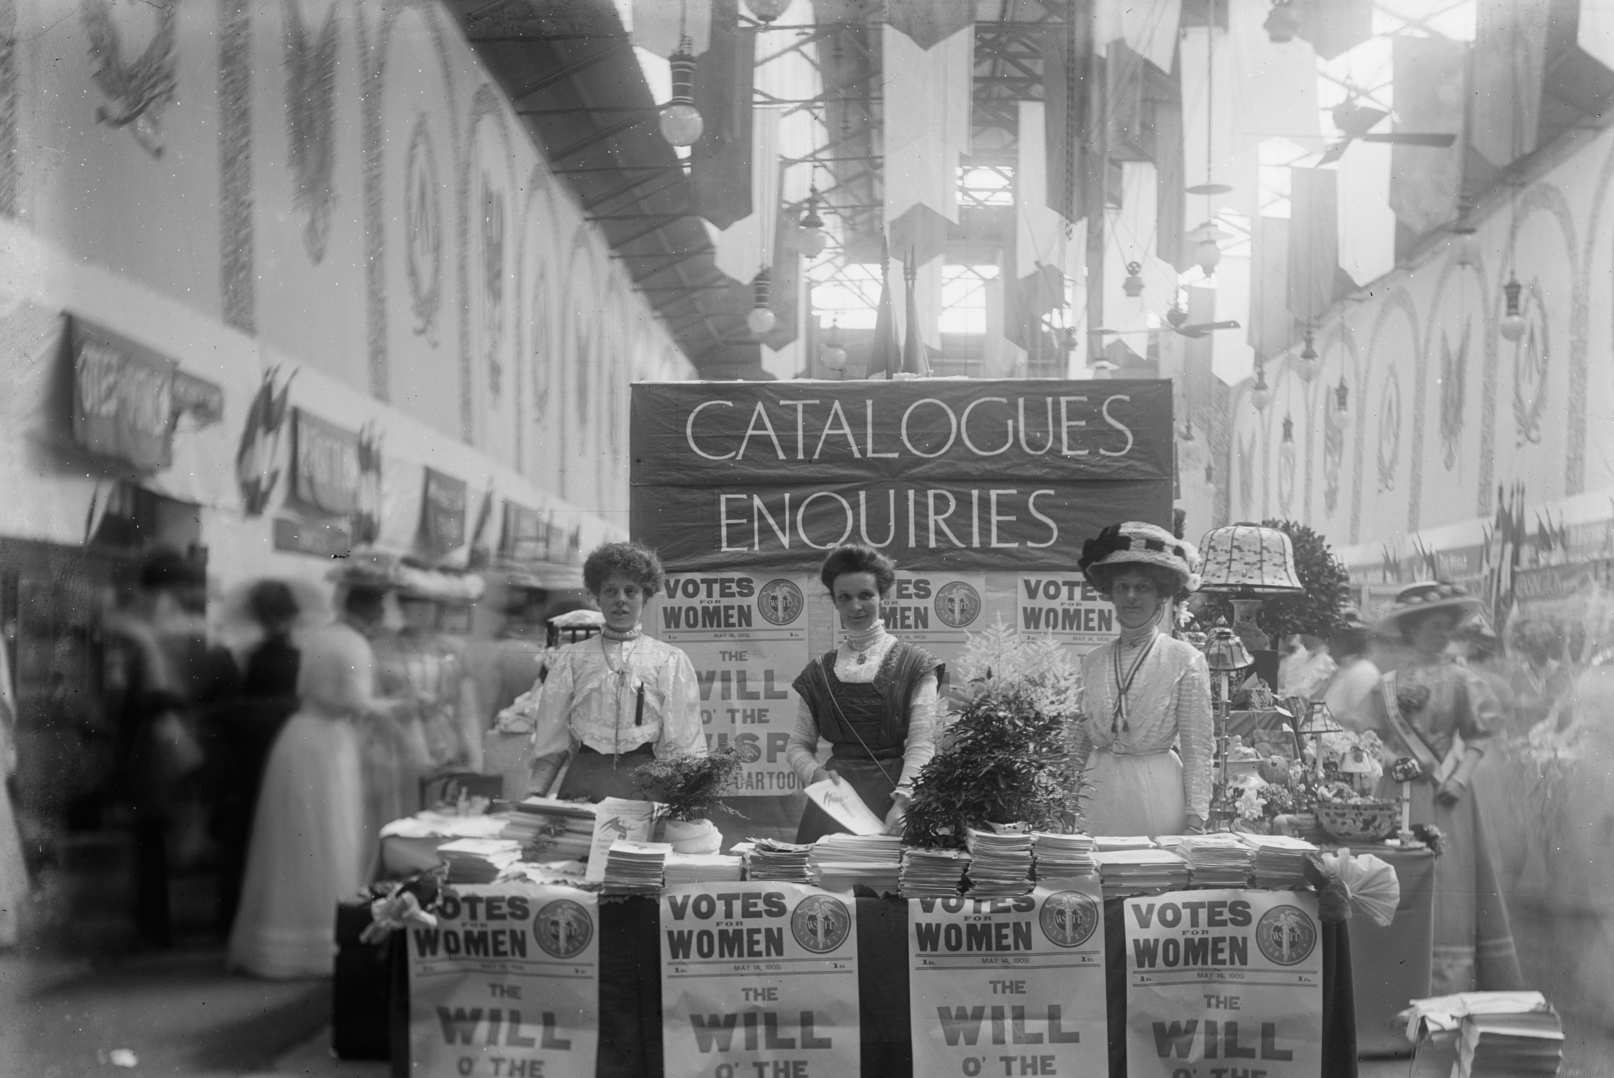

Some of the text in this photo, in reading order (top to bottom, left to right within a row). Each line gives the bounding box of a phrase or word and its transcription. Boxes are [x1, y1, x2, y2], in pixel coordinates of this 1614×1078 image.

[686, 395, 1134, 460] CATALOGUES
[720, 489, 1059, 552] ENQUIRIES
[664, 577, 755, 599] VOTES
[662, 605, 752, 629] WOMEN
[880, 606, 929, 629] MEN
[1022, 607, 1113, 632] WOMEN
[720, 651, 749, 662] THE
[726, 708, 770, 724] THE
[707, 733, 791, 763] ISP
[439, 896, 530, 921] OTES
[668, 891, 787, 920] VOTES
[1131, 900, 1253, 928] VOTES
[414, 929, 527, 958] WOMEN
[667, 927, 784, 960] WOMEN
[915, 922, 1032, 951] WOMEN
[1132, 936, 1248, 968] WOMEN
[488, 983, 522, 999] THE
[741, 987, 778, 1001] THE
[989, 980, 1026, 994] THE
[1203, 994, 1240, 1010] THE
[436, 1006, 572, 1051] WILL
[689, 1011, 832, 1053] WILL
[936, 1004, 1080, 1046] WILL
[1152, 1019, 1293, 1062] WILL
[490, 1058, 545, 1078] THE
[752, 1060, 809, 1078] THE
[962, 1055, 1057, 1077] O' THE
